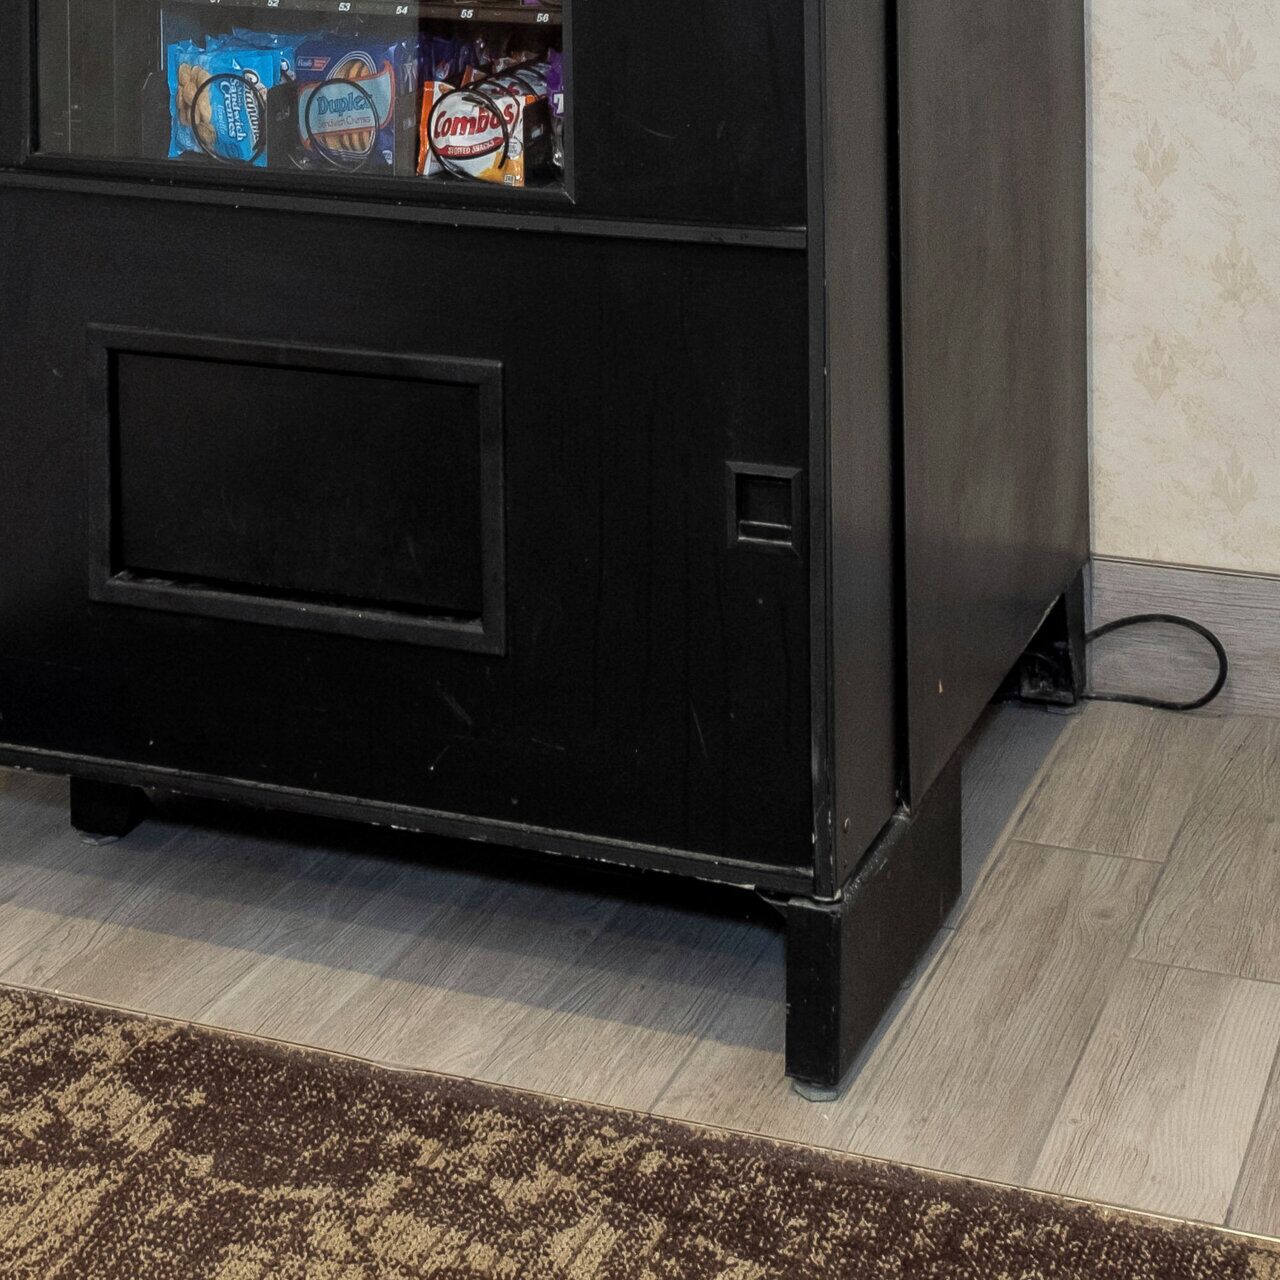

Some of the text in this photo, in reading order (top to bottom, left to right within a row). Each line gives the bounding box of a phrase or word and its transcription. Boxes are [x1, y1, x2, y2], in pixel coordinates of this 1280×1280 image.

[338, 2, 351, 11] 53
[396, 5, 408, 15] 54
[461, 9, 473, 18] 55
[536, 13, 549, 23] 56
[230, 78, 247, 142] Sandwich
